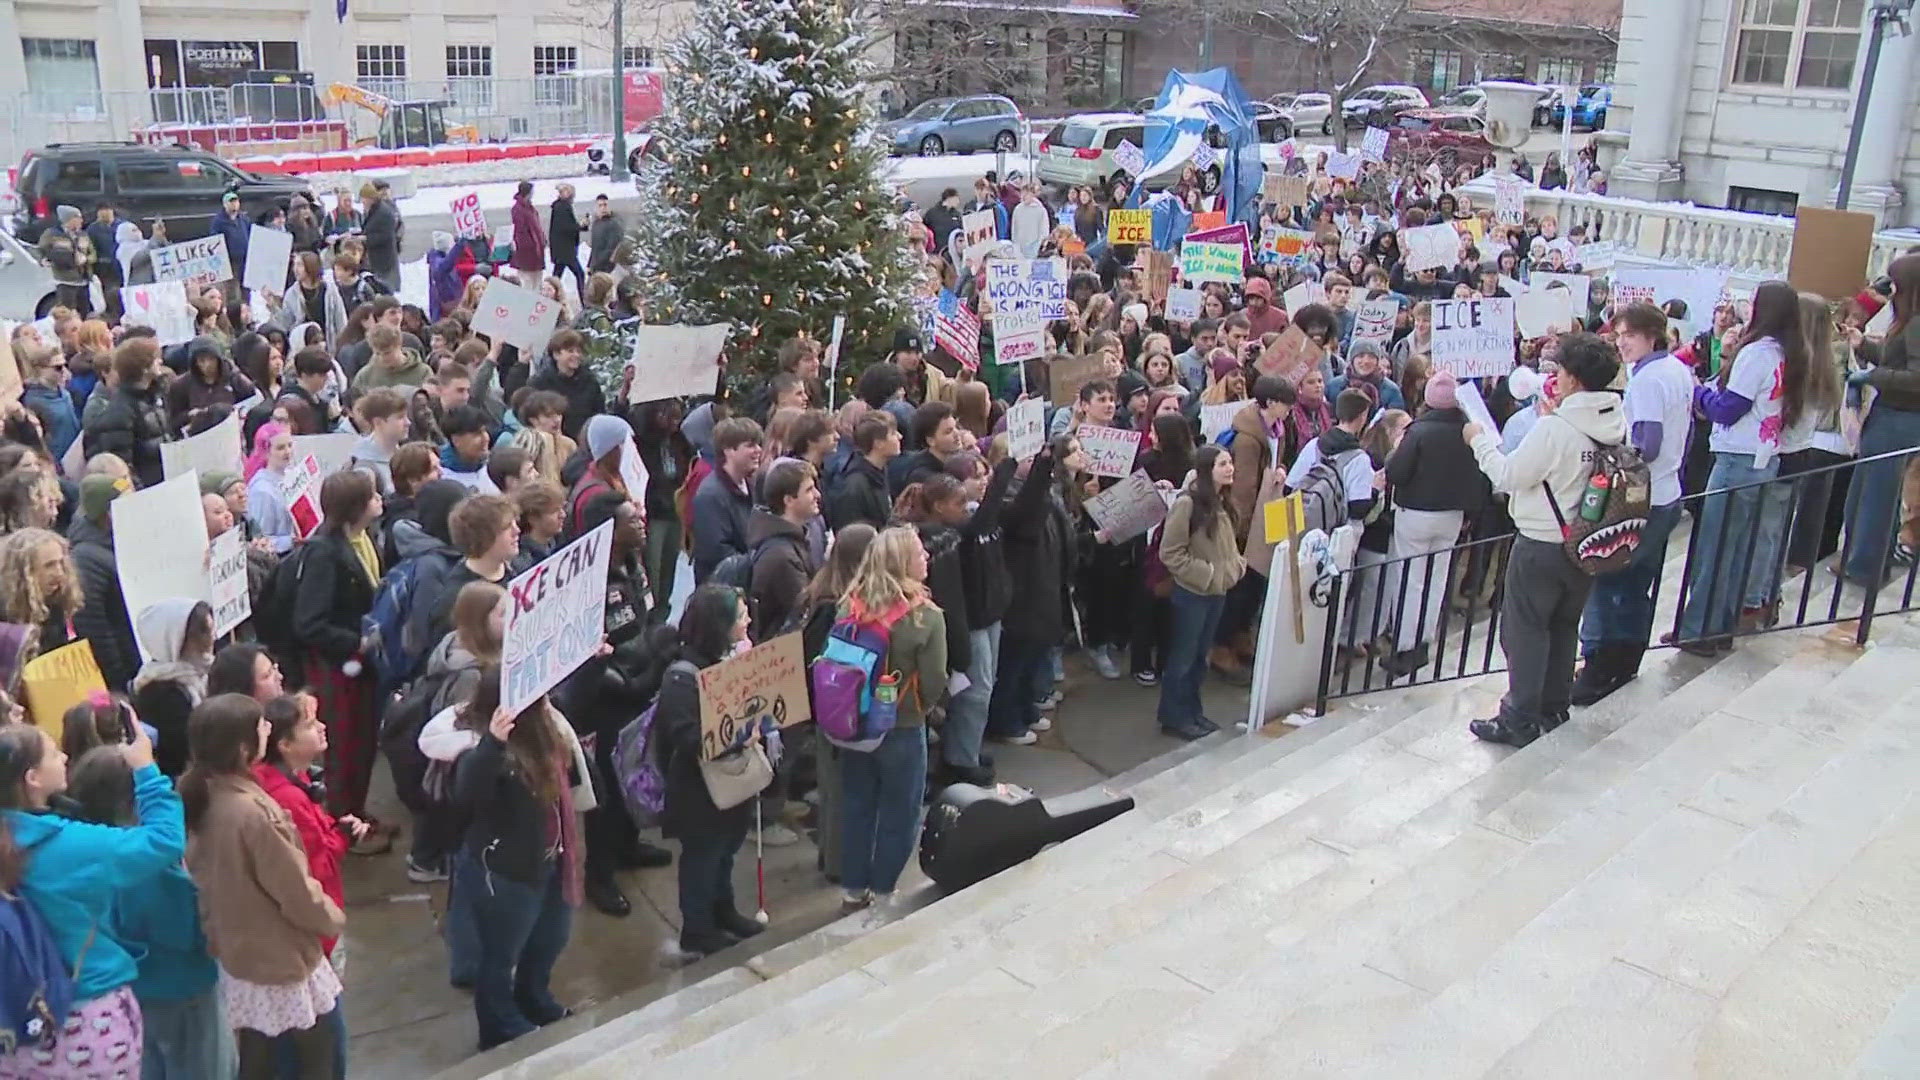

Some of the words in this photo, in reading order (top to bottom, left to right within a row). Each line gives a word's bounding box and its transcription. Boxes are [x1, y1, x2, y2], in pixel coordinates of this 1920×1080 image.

[453, 193, 478, 213] NO
[456, 209, 481, 230] ICE
[1117, 227, 1145, 241] ICE
[175, 243, 208, 262] LIKE
[992, 264, 1018, 277] THE
[989, 280, 1043, 298] WRONG
[1047, 282, 1066, 299] ICE
[995, 300, 1008, 313] IS
[1360, 303, 1388, 319] Today
[1436, 301, 1481, 330] ICE
[556, 535, 602, 588] CAN
[508, 635, 554, 708] FAT
[558, 601, 601, 667] ONE
